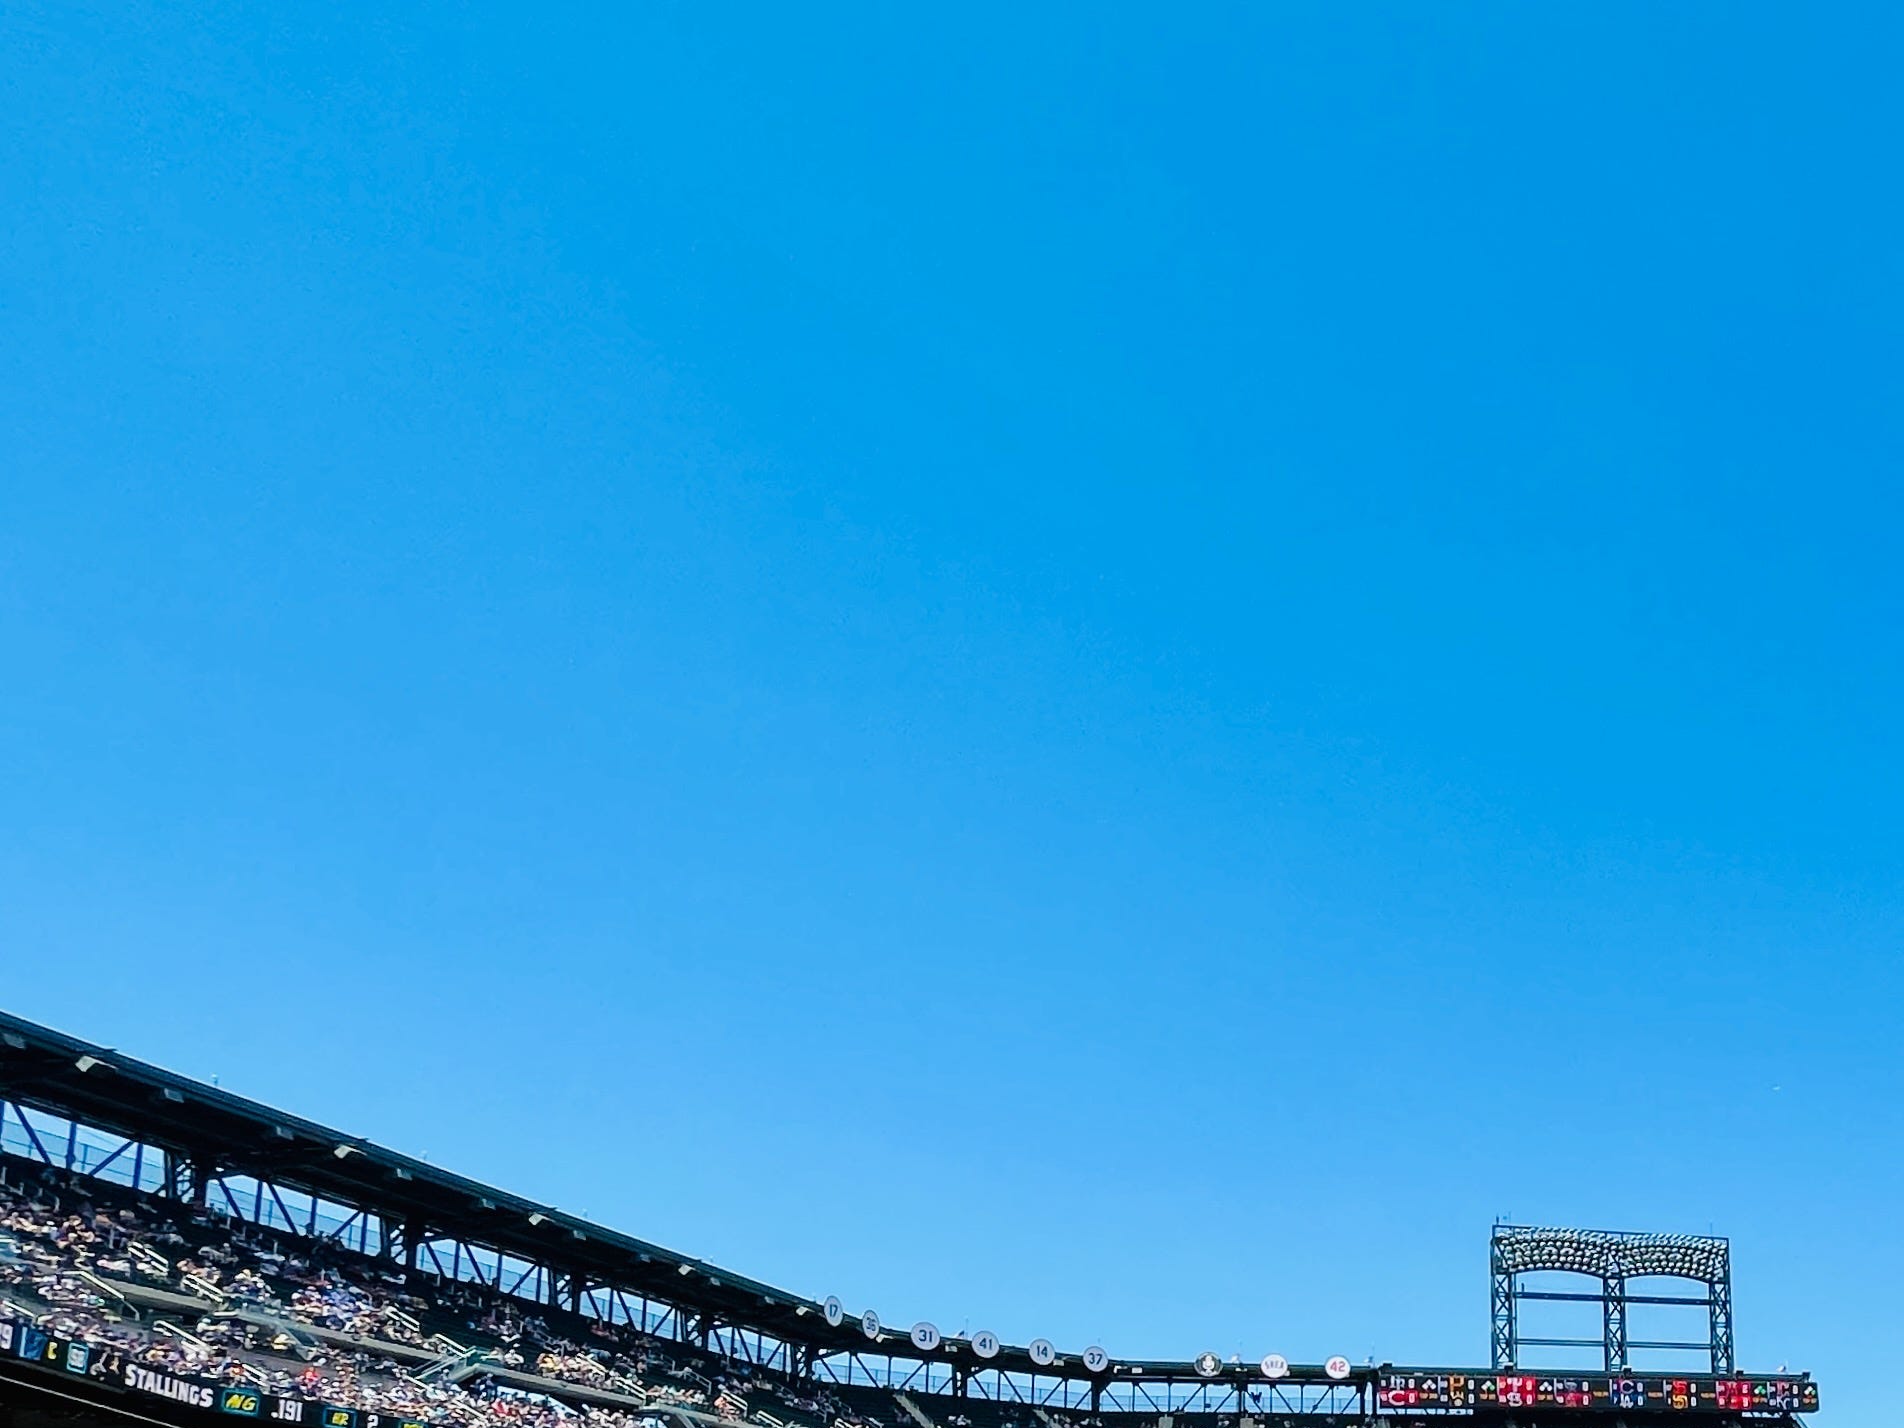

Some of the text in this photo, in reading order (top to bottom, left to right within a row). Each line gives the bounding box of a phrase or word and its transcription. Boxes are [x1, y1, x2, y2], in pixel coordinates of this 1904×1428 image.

[828, 1304, 839, 1317] 17
[866, 1318, 876, 1332] 36
[918, 1329, 933, 1343] 31
[979, 1338, 993, 1350] 41
[1036, 1346, 1048, 1358] 14
[1088, 1353, 1103, 1365] 37
[1330, 1361, 1346, 1372] 42
[125, 1364, 214, 1408] STALLINGS
[271, 1399, 303, 1421] .191
